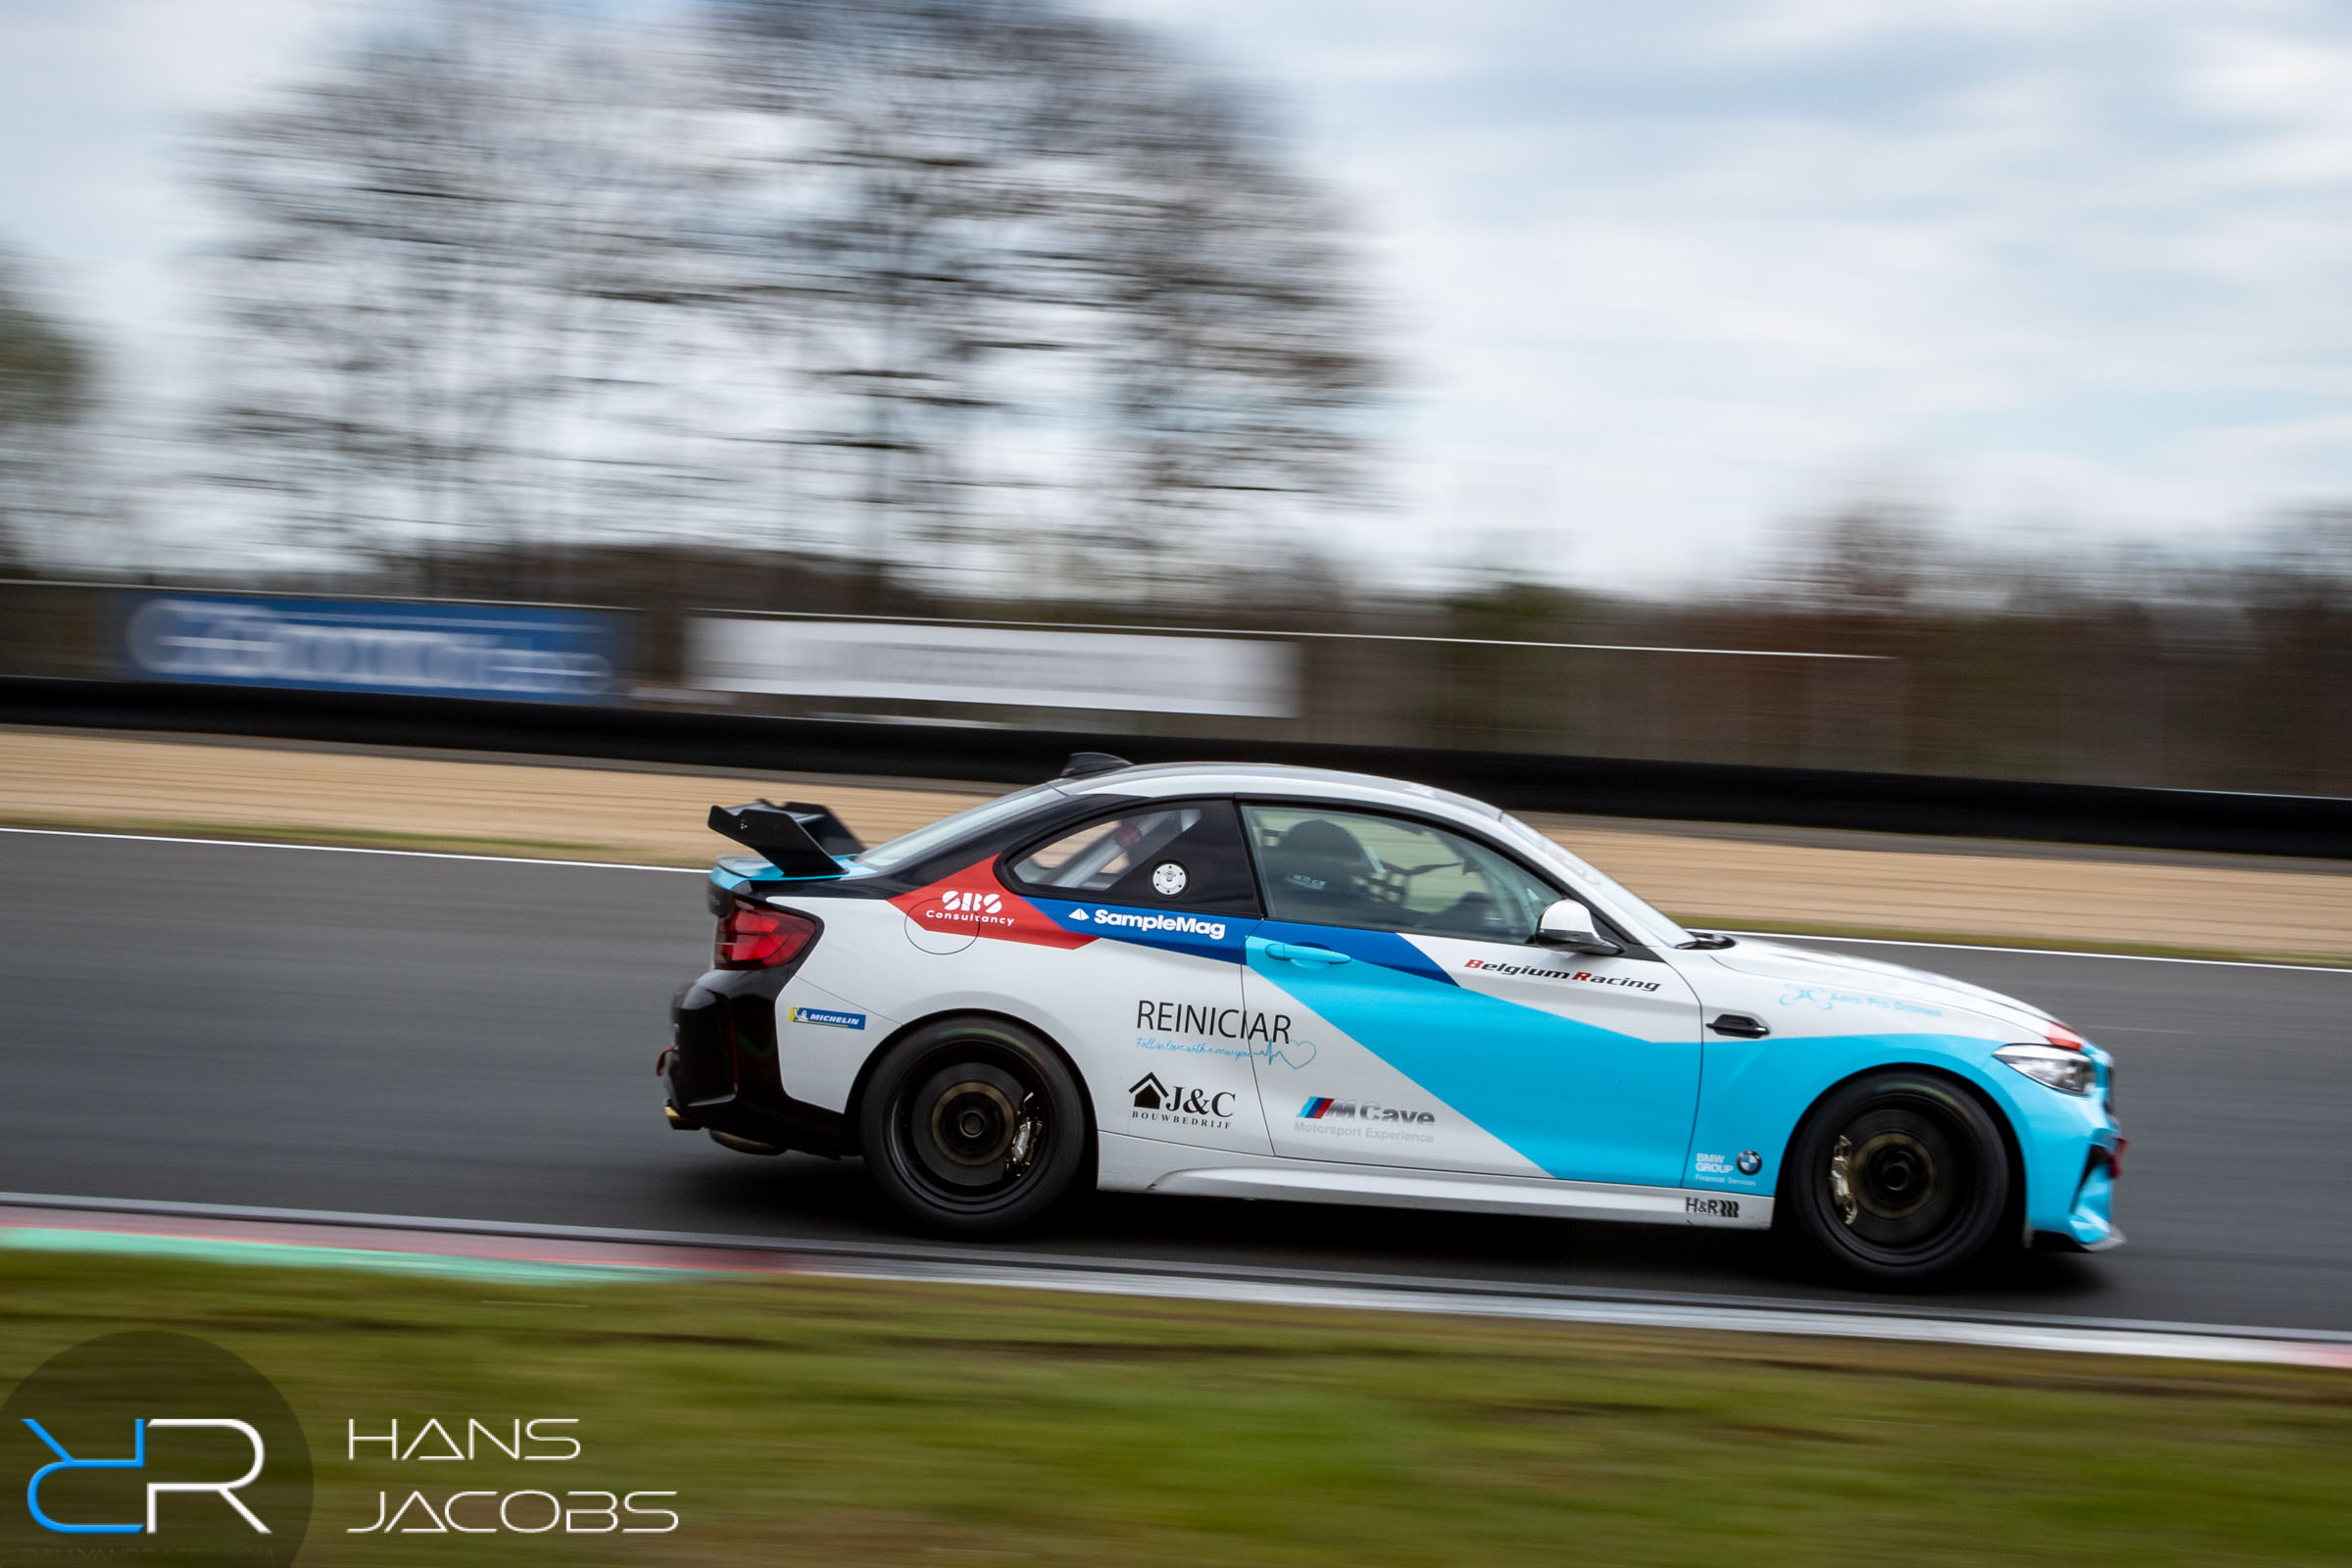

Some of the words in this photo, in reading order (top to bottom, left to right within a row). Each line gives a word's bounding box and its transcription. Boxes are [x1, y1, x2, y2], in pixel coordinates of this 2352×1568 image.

[926, 909, 1014, 927] Consultancy
[1094, 908, 1226, 941] SampleMag
[809, 1013, 859, 1025] MICHELIN
[1137, 1000, 1292, 1045] REINICIAR
[1165, 1086, 1236, 1118] J&C
[1132, 1110, 1232, 1130] BOUWBEDRIJF
[1294, 1121, 1362, 1138] Motorsport
[1365, 1127, 1435, 1144] Experience
[1696, 1152, 1725, 1163] BMW
[1695, 1162, 1734, 1174] GROUP
[1686, 1197, 1718, 1215] H&R
